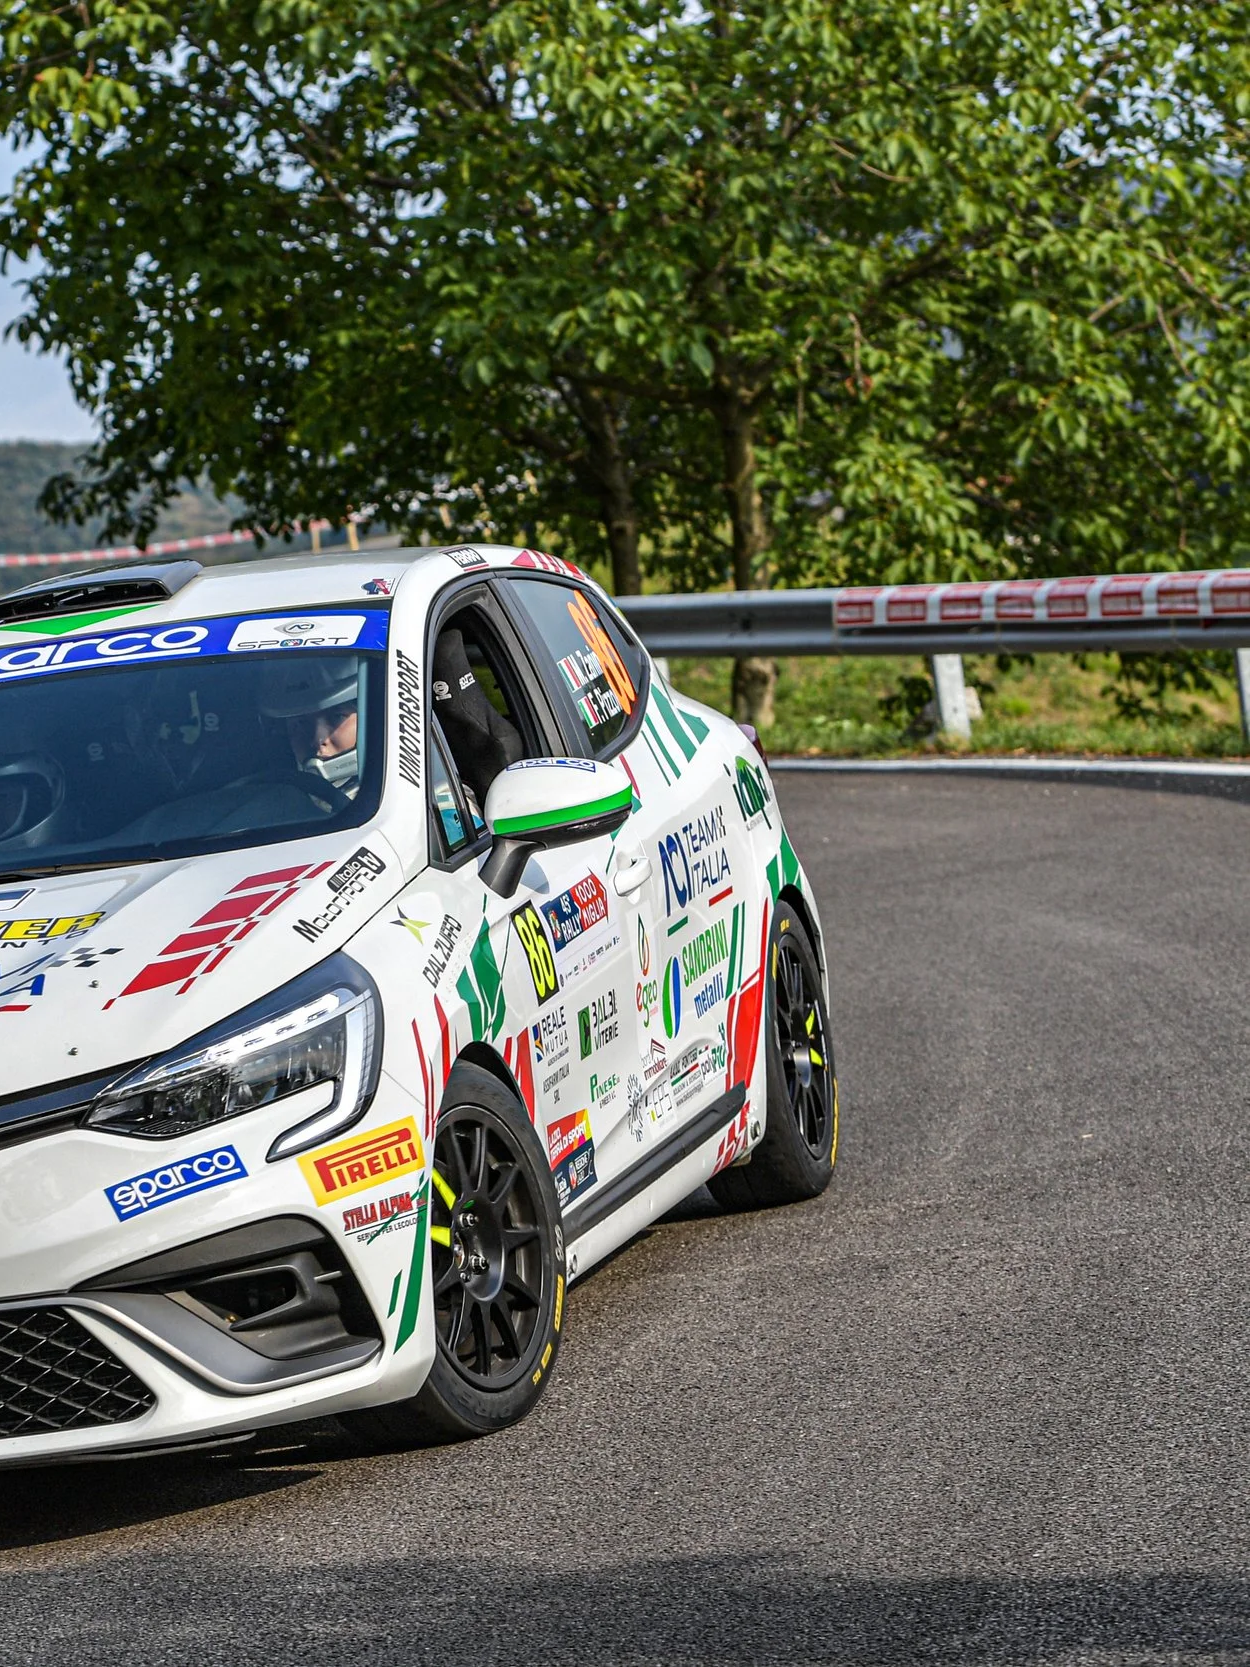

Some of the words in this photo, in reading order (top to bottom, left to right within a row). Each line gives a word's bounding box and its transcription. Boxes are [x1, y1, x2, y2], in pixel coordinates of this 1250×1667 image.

[235, 637, 348, 650] SPORT
[566, 589, 636, 715] 86
[396, 649, 420, 788] VIMOTORSPORT
[682, 811, 718, 858] TEAM
[337, 861, 362, 888] Italia
[575, 878, 597, 904] 1000
[691, 847, 731, 898] ITALIA
[561, 913, 583, 942] RALLY
[582, 896, 606, 928] MIGLIA
[515, 908, 555, 998] 86
[682, 918, 728, 987] SANDRINI
[636, 979, 657, 1028] egeo
[694, 971, 724, 1019] metalli
[541, 1005, 566, 1039] REALE
[545, 1030, 568, 1057] MUTUA
[569, 1120, 587, 1144] SPORT
[114, 1151, 237, 1211] sparco
[313, 1128, 418, 1192] PIRELLI
[343, 1203, 378, 1232] STELLA
